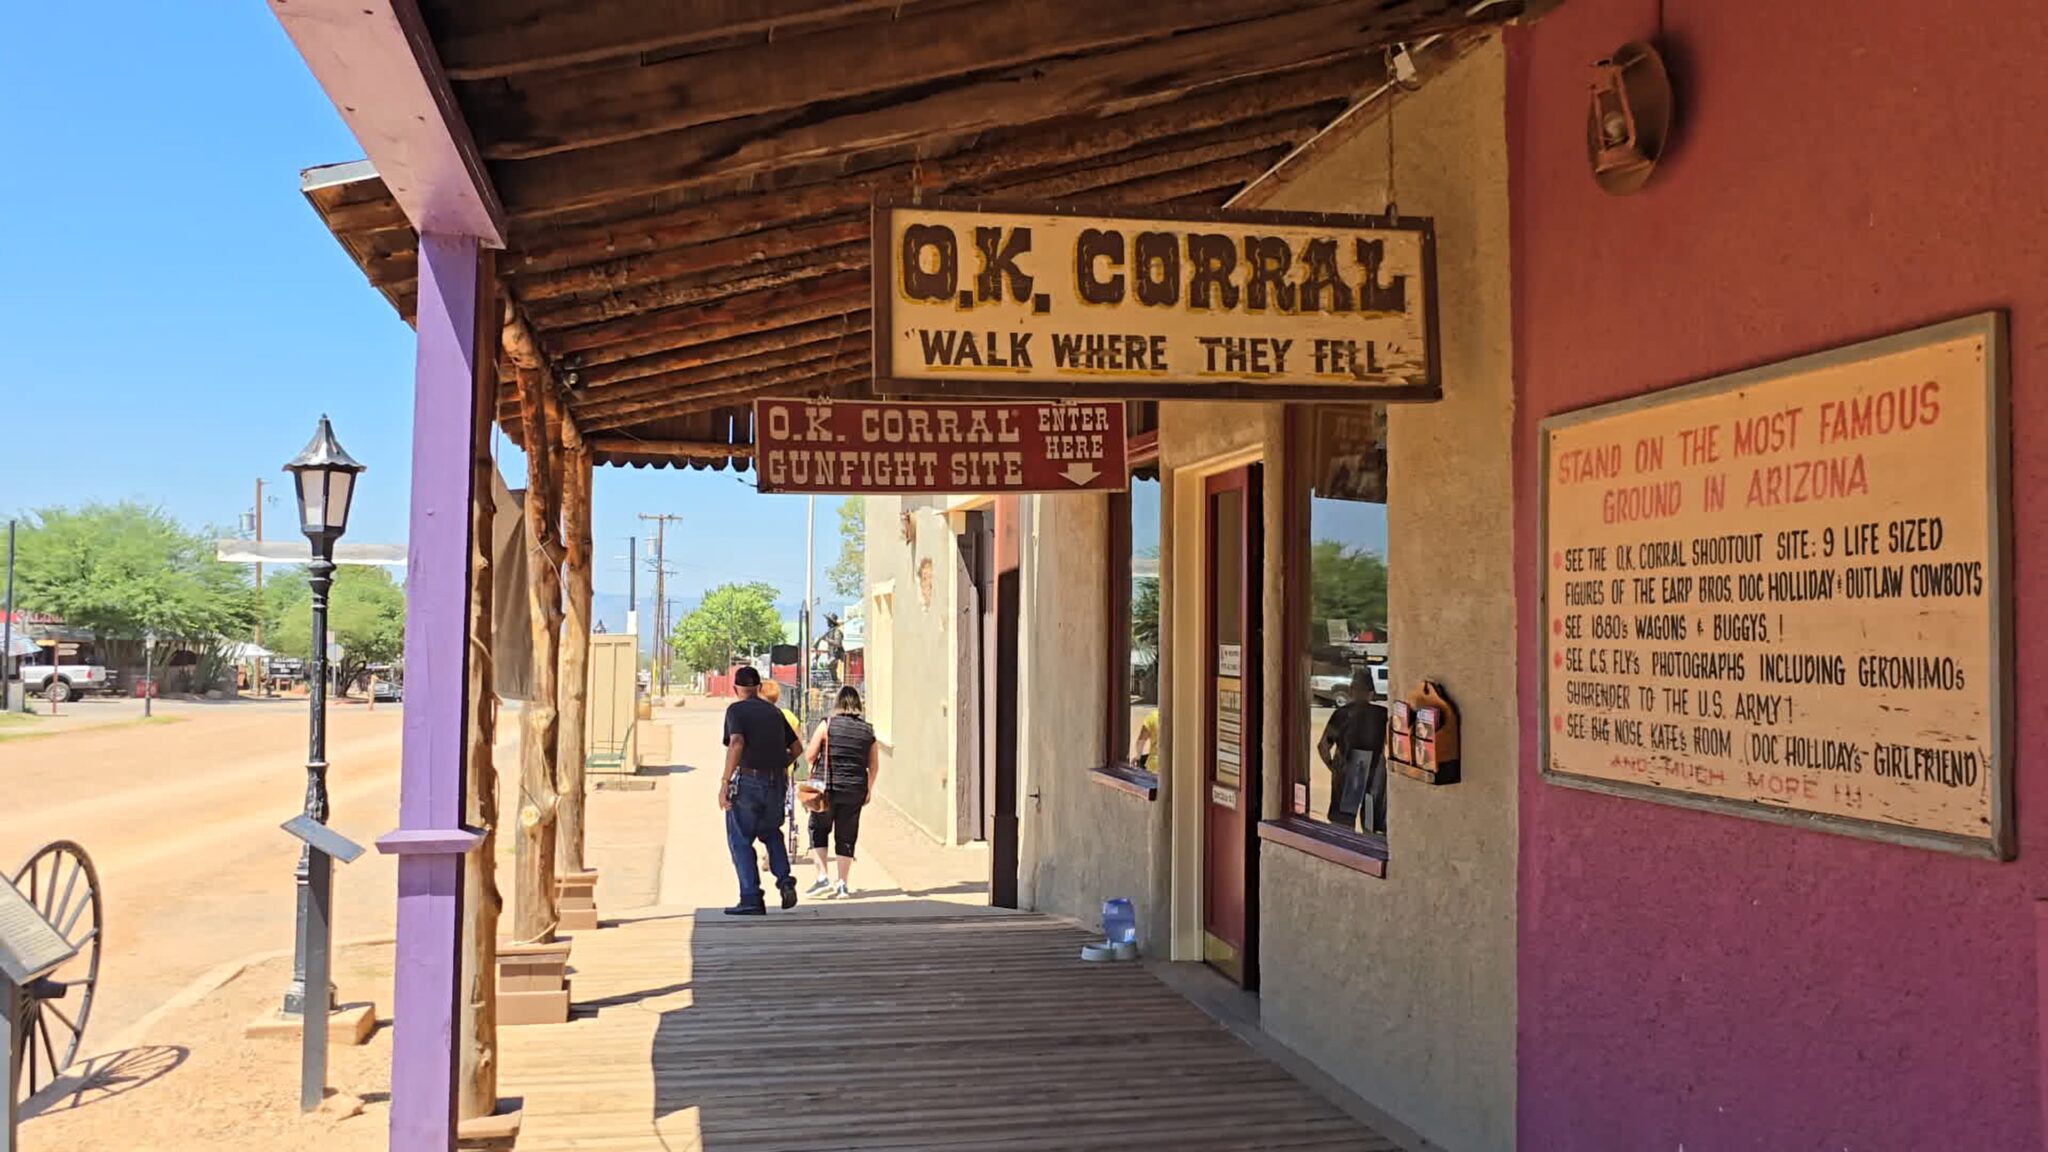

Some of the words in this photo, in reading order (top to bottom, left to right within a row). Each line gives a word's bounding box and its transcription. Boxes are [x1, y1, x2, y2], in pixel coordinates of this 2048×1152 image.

[900, 223, 1050, 314] O.K.
[1075, 225, 1406, 316] CORRAL
[1052, 333, 1168, 371] WHERE
[1195, 336, 1293, 373] THEY
[768, 406, 845, 441] O.K.
[1038, 407, 1109, 432] ENTER
[1558, 444, 1621, 484] STAND
[1635, 436, 1664, 473] ON
[1679, 425, 1720, 467] THE
[1733, 407, 1803, 459] MOST
[1820, 381, 1941, 444] FAMOUS
[1045, 435, 1103, 459] HERE
[768, 450, 938, 486] GUNFIGHT
[951, 451, 1022, 486] SITE
[1603, 480, 1682, 524] GROUND
[1704, 474, 1726, 512] IN
[1746, 453, 1868, 507] ARIZONA
[1565, 548, 1584, 572] SEE
[1588, 547, 1607, 571] THE
[1616, 545, 1636, 571] O.K.
[1639, 541, 1687, 569] CORRAL
[1692, 534, 1763, 566] SHOOTOUT
[1777, 530, 1816, 560] SITE:
[1823, 527, 1835, 557] 9
[1844, 523, 1880, 556] LIFE
[1888, 517, 1944, 553] SIZED
[1565, 580, 1604, 606] FIGURES
[1611, 579, 1625, 604] OF
[1632, 577, 1655, 603] THE
[1662, 576, 1692, 603] EARP
[1699, 575, 1733, 603] BROS.
[1739, 573, 1764, 602] DOC
[1768, 569, 1835, 601] HOLLIDAY
[1846, 565, 1904, 599] OUTLAW
[1911, 561, 1983, 598] COWBOYS
[1565, 614, 1582, 639] SEE
[1635, 614, 1687, 641] WAGONS
[1566, 648, 1583, 673] SEE
[1590, 648, 1609, 675] C.S.
[1652, 651, 1745, 682] PHOTOGRAPHS
[1760, 654, 1846, 685] INCLUDING
[1566, 681, 1630, 711] SURRENDER
[1638, 686, 1655, 712] TO
[1663, 688, 1689, 715] THE
[1698, 690, 1726, 720] U.S.
[1567, 714, 1585, 739] SEE
[1591, 716, 1610, 742] BIG
[1615, 719, 1644, 748] NOSE
[1694, 726, 1732, 759] ROOM
[1610, 755, 1646, 773] AND
[1664, 758, 1725, 786] MUCH
[1747, 772, 1819, 799] MORE
